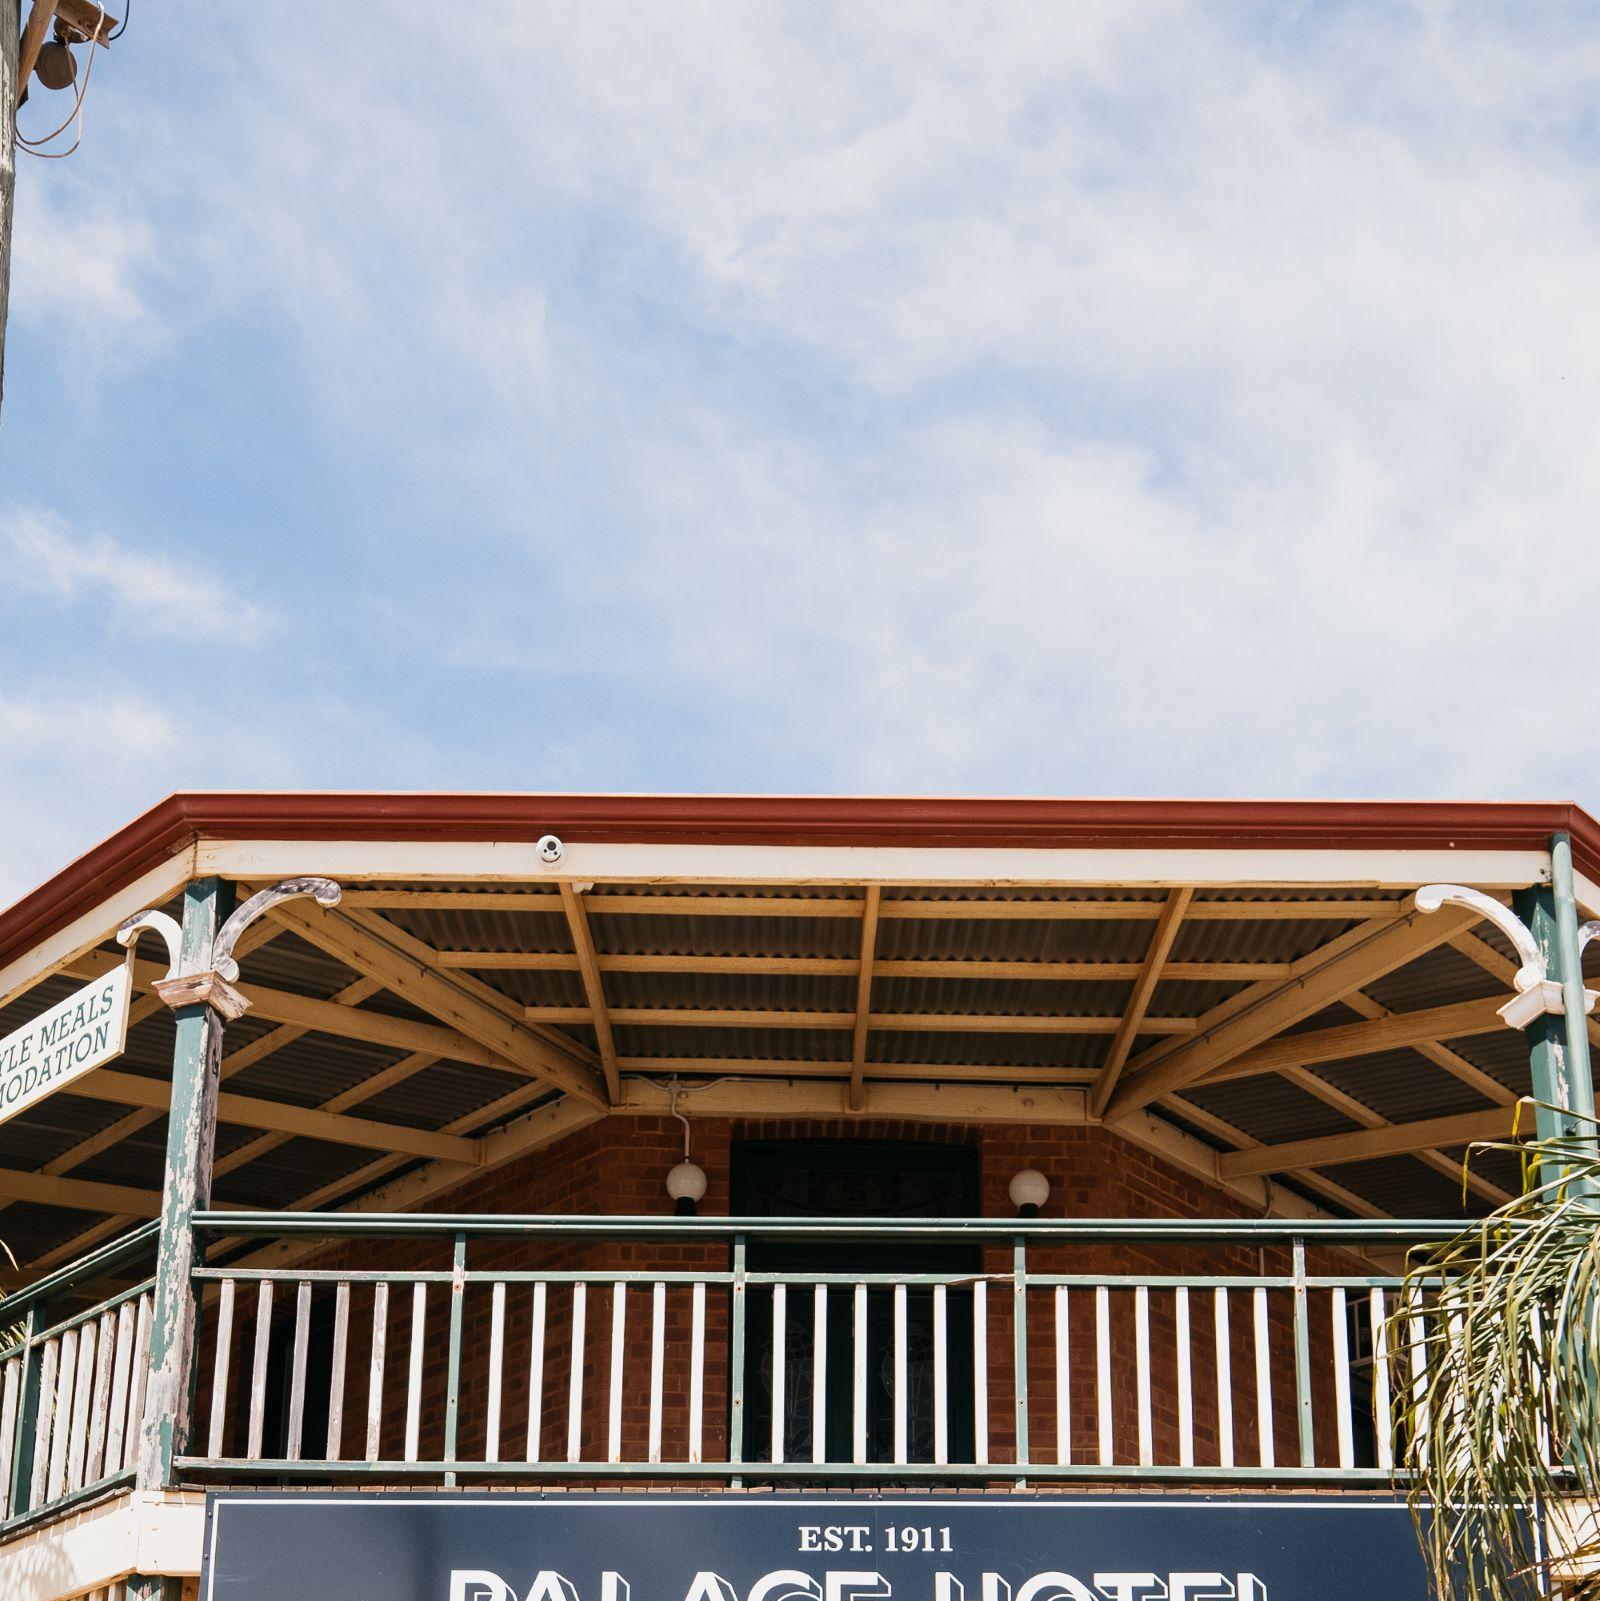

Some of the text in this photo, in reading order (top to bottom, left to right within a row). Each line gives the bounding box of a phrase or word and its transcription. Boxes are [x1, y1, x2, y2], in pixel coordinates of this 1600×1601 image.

[38, 985, 113, 1054] MEALS
[798, 1526, 954, 1552] EST. 1911
